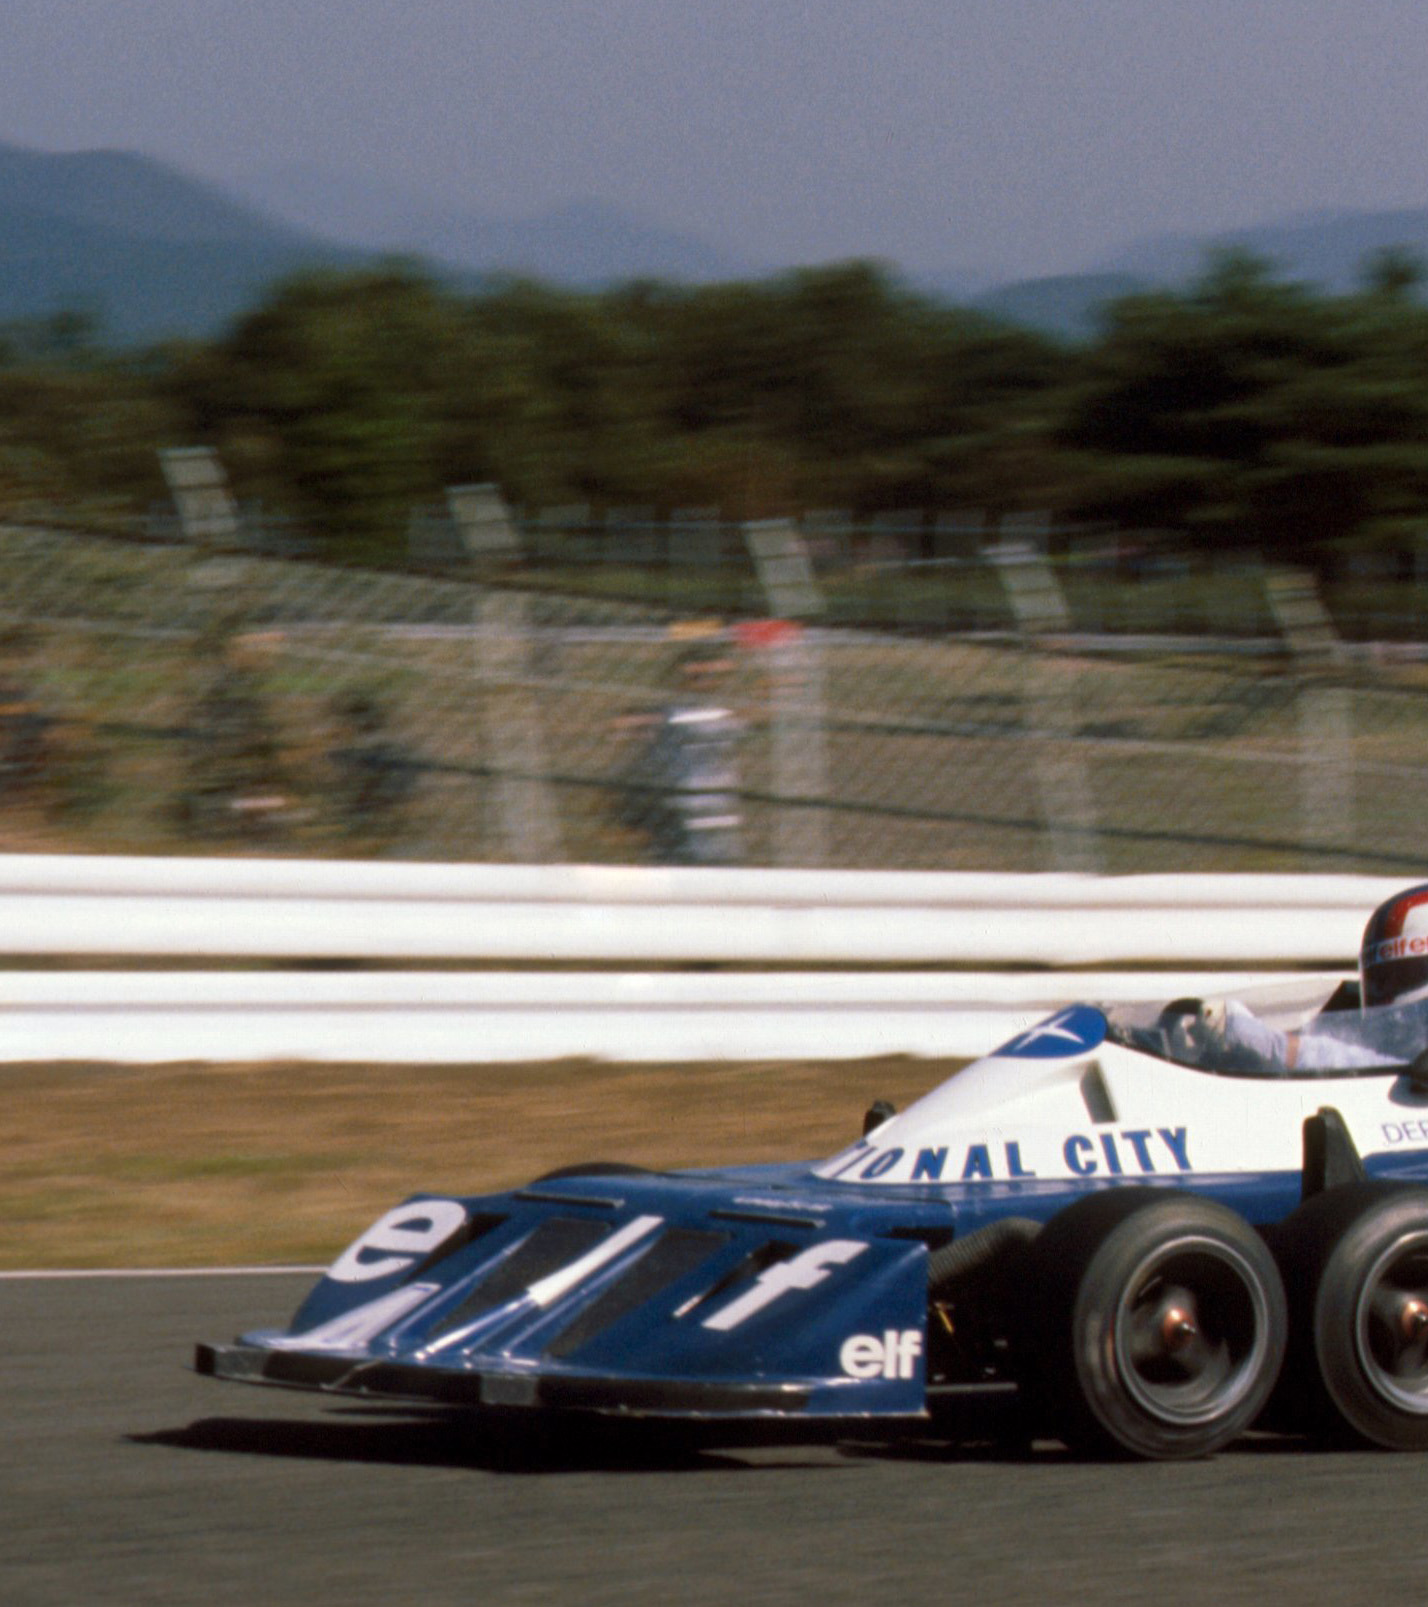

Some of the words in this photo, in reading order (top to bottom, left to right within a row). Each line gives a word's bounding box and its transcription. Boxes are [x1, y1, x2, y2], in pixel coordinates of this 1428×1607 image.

[828, 1139, 1036, 1181] IONAL
[1062, 1126, 1194, 1177] CITY
[840, 1329, 923, 1379] elf
